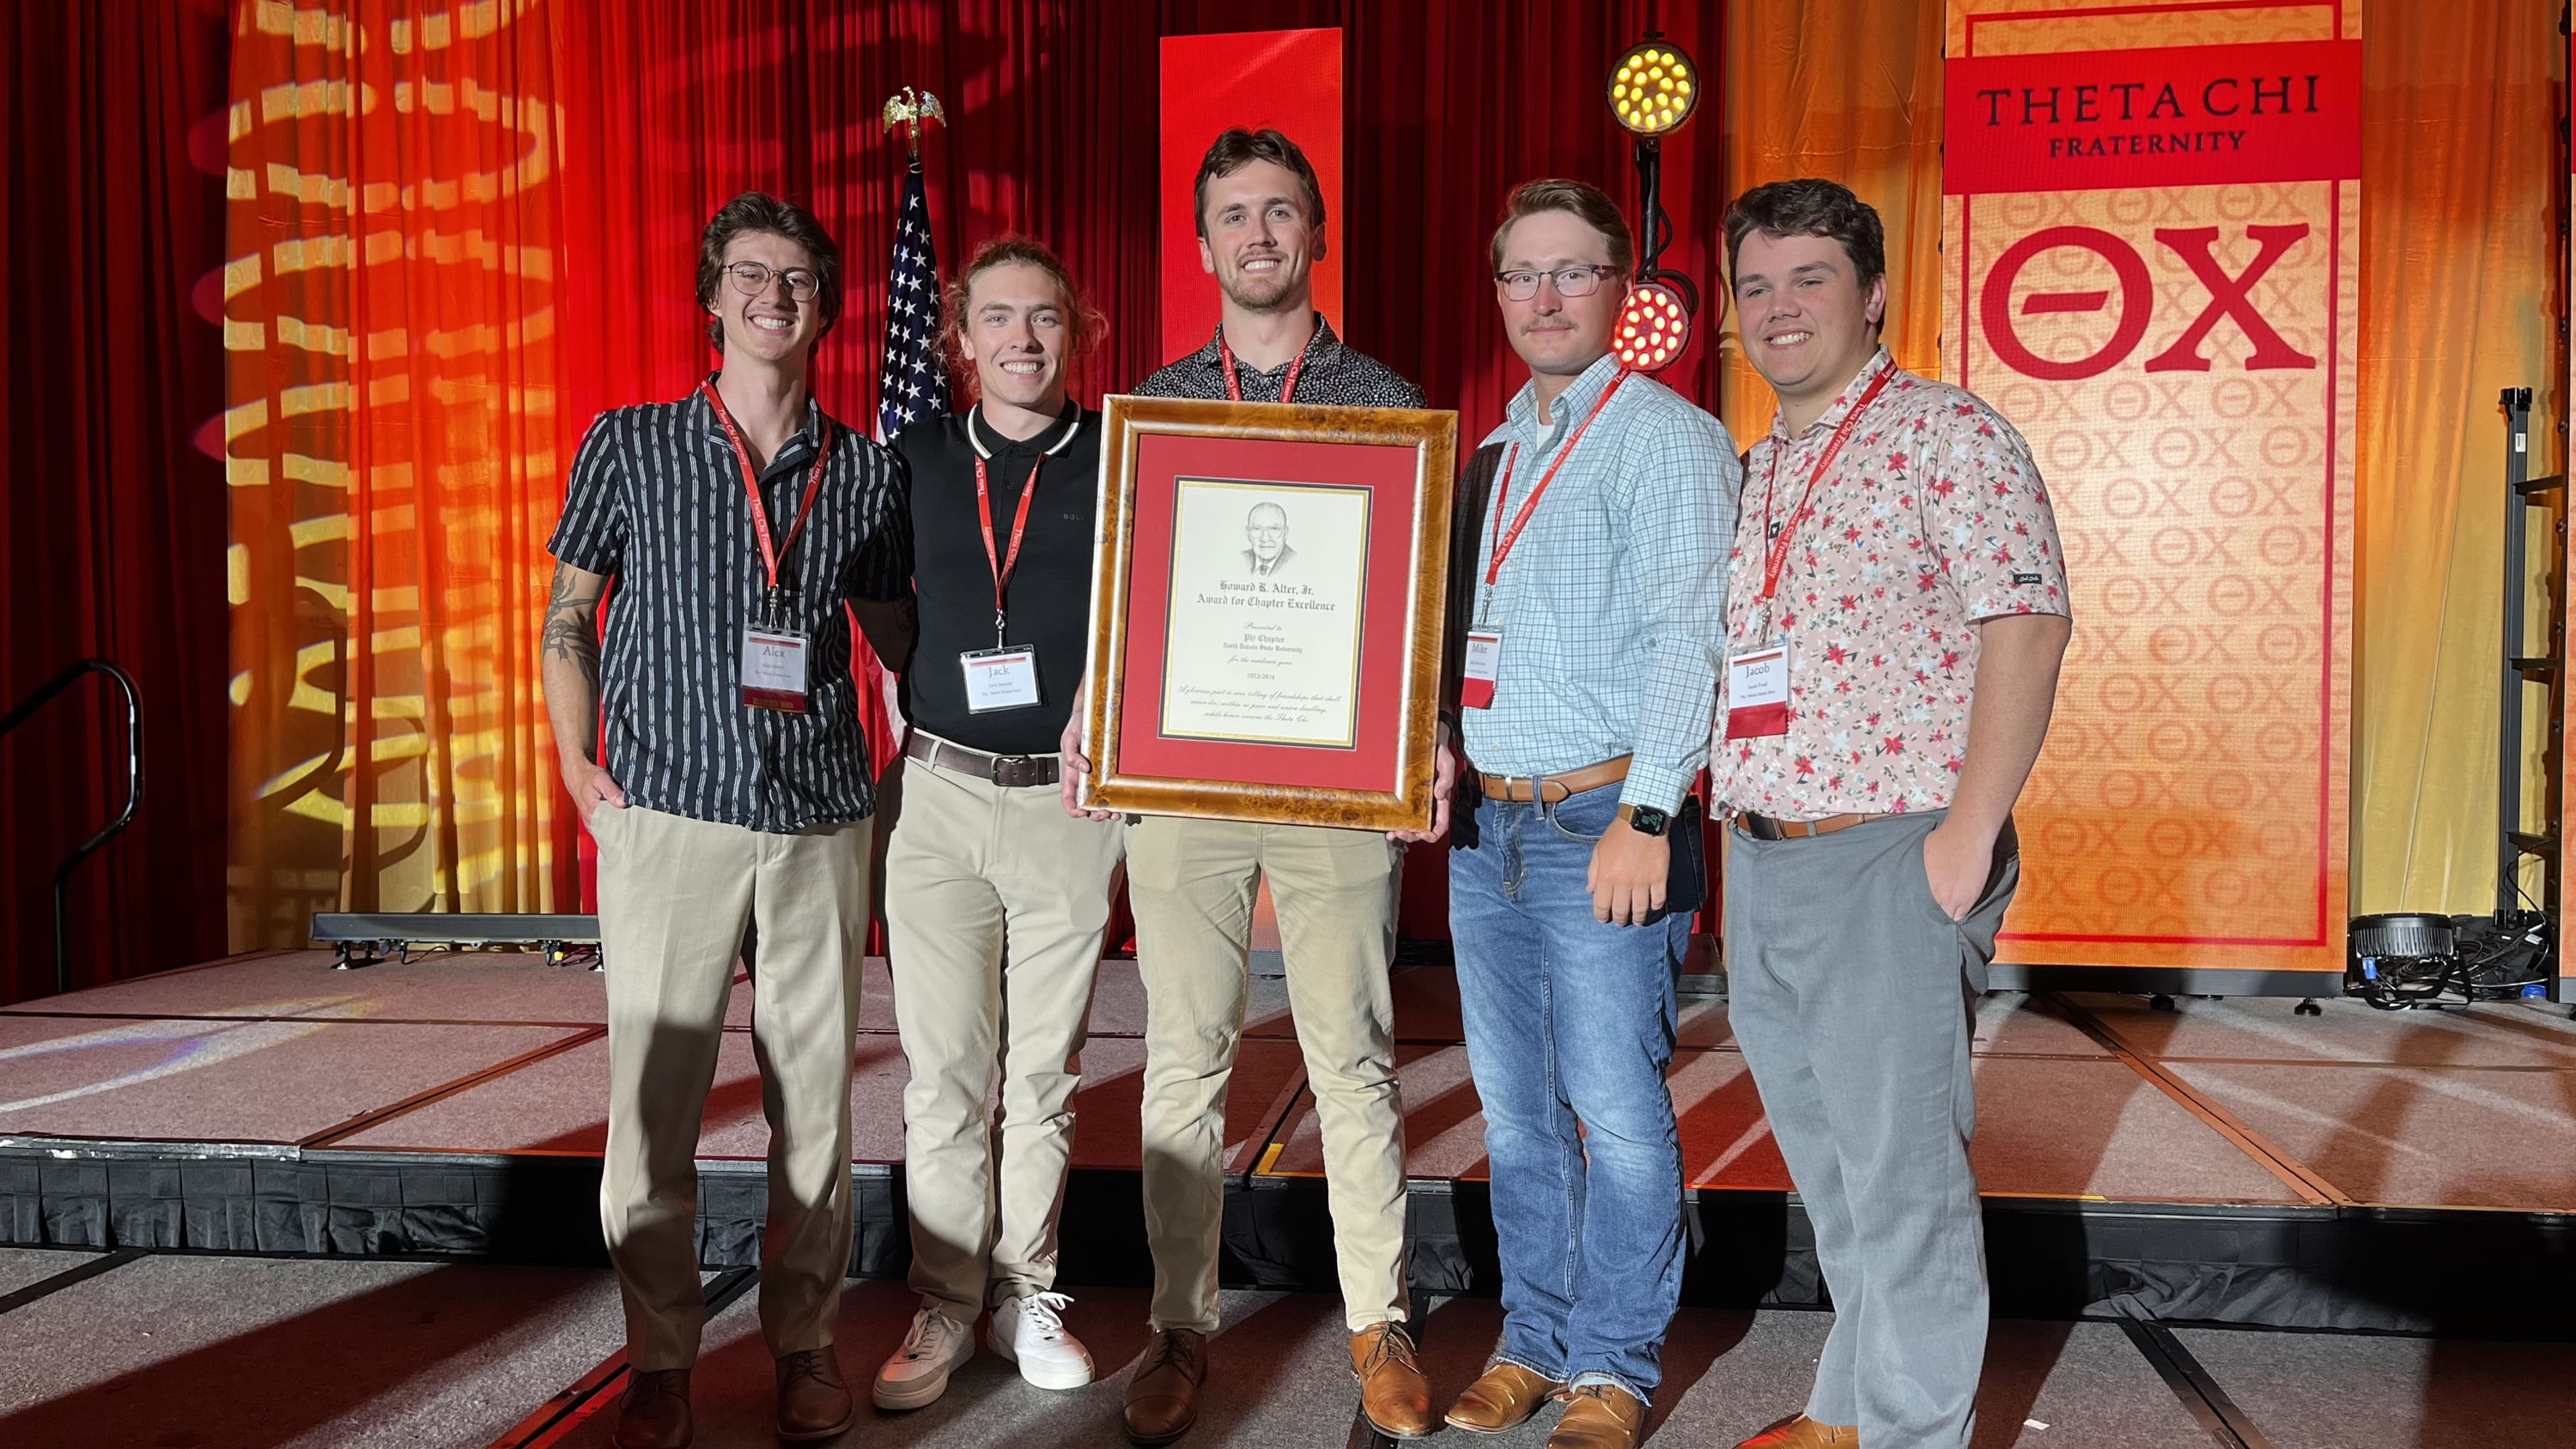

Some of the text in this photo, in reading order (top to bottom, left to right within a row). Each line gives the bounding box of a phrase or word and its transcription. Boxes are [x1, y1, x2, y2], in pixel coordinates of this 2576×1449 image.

[1978, 76, 2320, 126] THETA CHI
[2050, 130, 2246, 158] FRATERNITY
[1819, 403, 1867, 470] Theta Chi Fraternity
[753, 498, 762, 517] Theta
[758, 518, 767, 532] Chi
[1503, 534, 1513, 546] Chi
[1510, 502, 1534, 533] Fraternity
[1784, 526, 1794, 540] Chi
[1768, 541, 1788, 578] Fraternity
[1219, 580, 1255, 591] Howard
[1197, 593, 1335, 612] Award for Chapter Excellence
[762, 646, 786, 658] Alex
[1472, 643, 1488, 653] Mike
[988, 665, 1010, 678] Jack
[1746, 663, 1770, 678] Jacob
